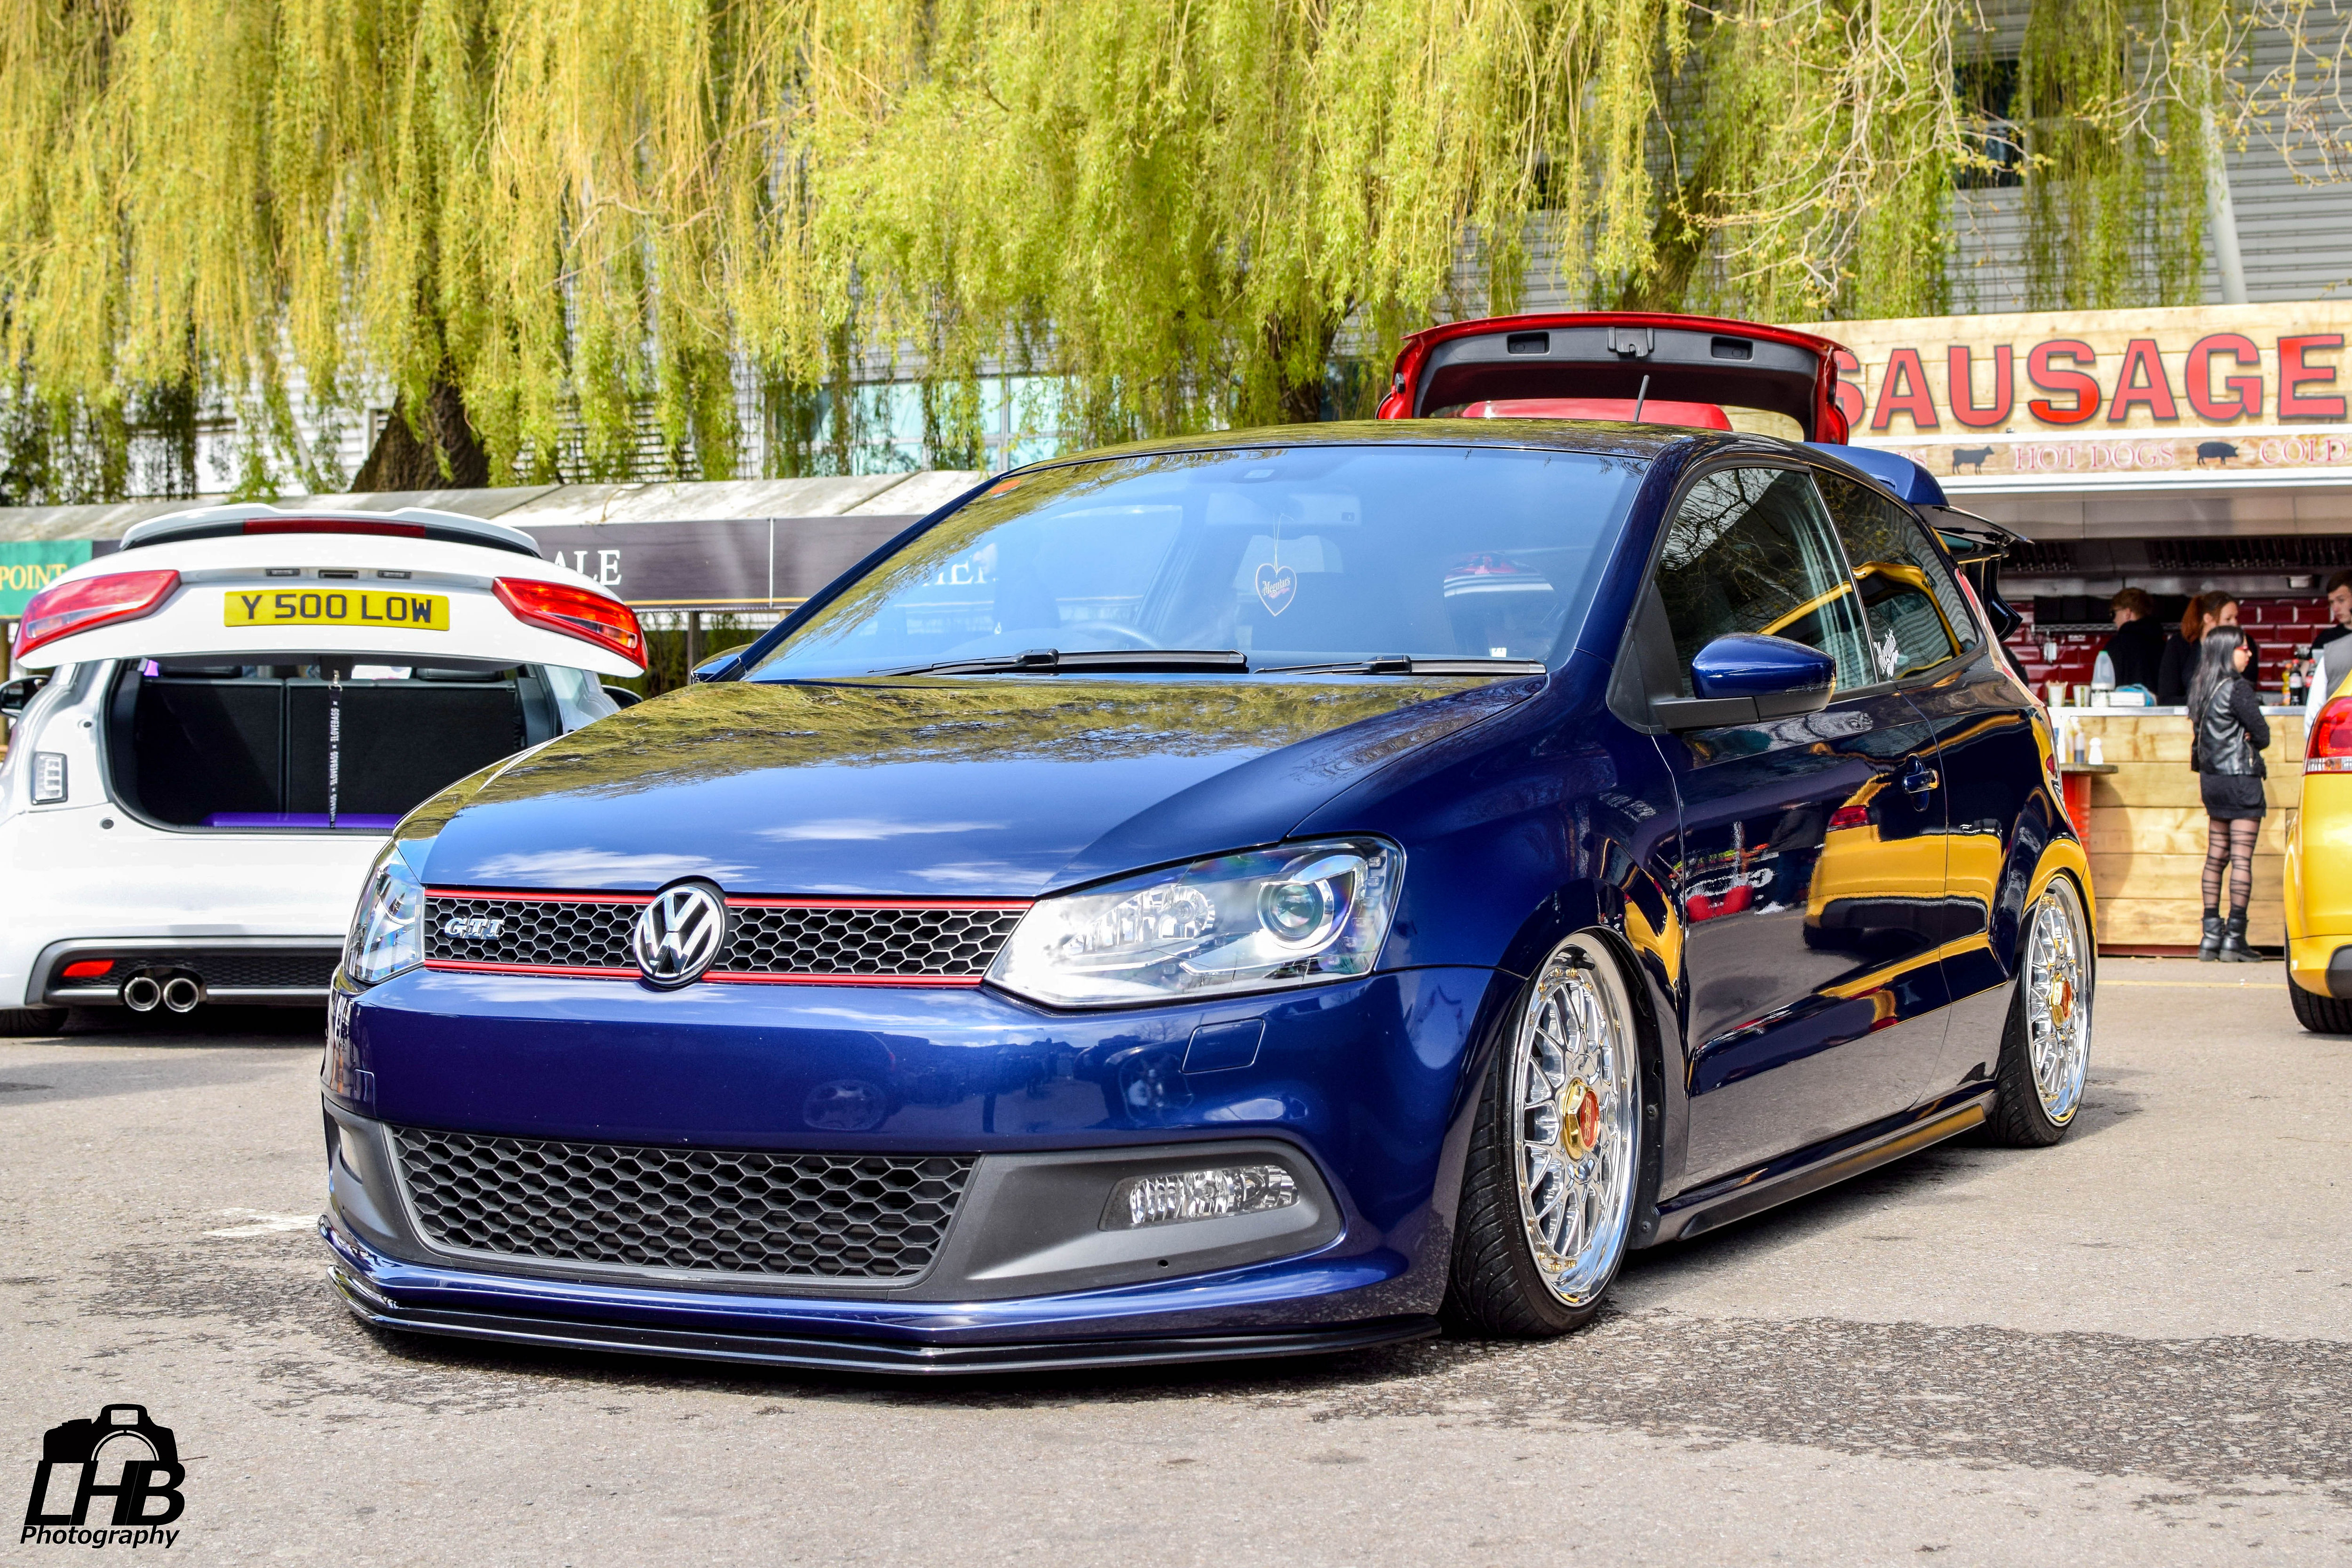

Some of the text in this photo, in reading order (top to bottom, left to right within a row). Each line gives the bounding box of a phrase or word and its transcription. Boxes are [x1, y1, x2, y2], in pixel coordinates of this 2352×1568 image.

[2015, 444, 2082, 471] HOT
[2089, 441, 2176, 469] DOGS
[2259, 438, 2347, 465] COLD
[0, 564, 67, 591] POINT
[241, 594, 432, 623] Y 500 LOW
[445, 917, 505, 940] GTI
[1583, 1096, 1592, 1141] BBS
